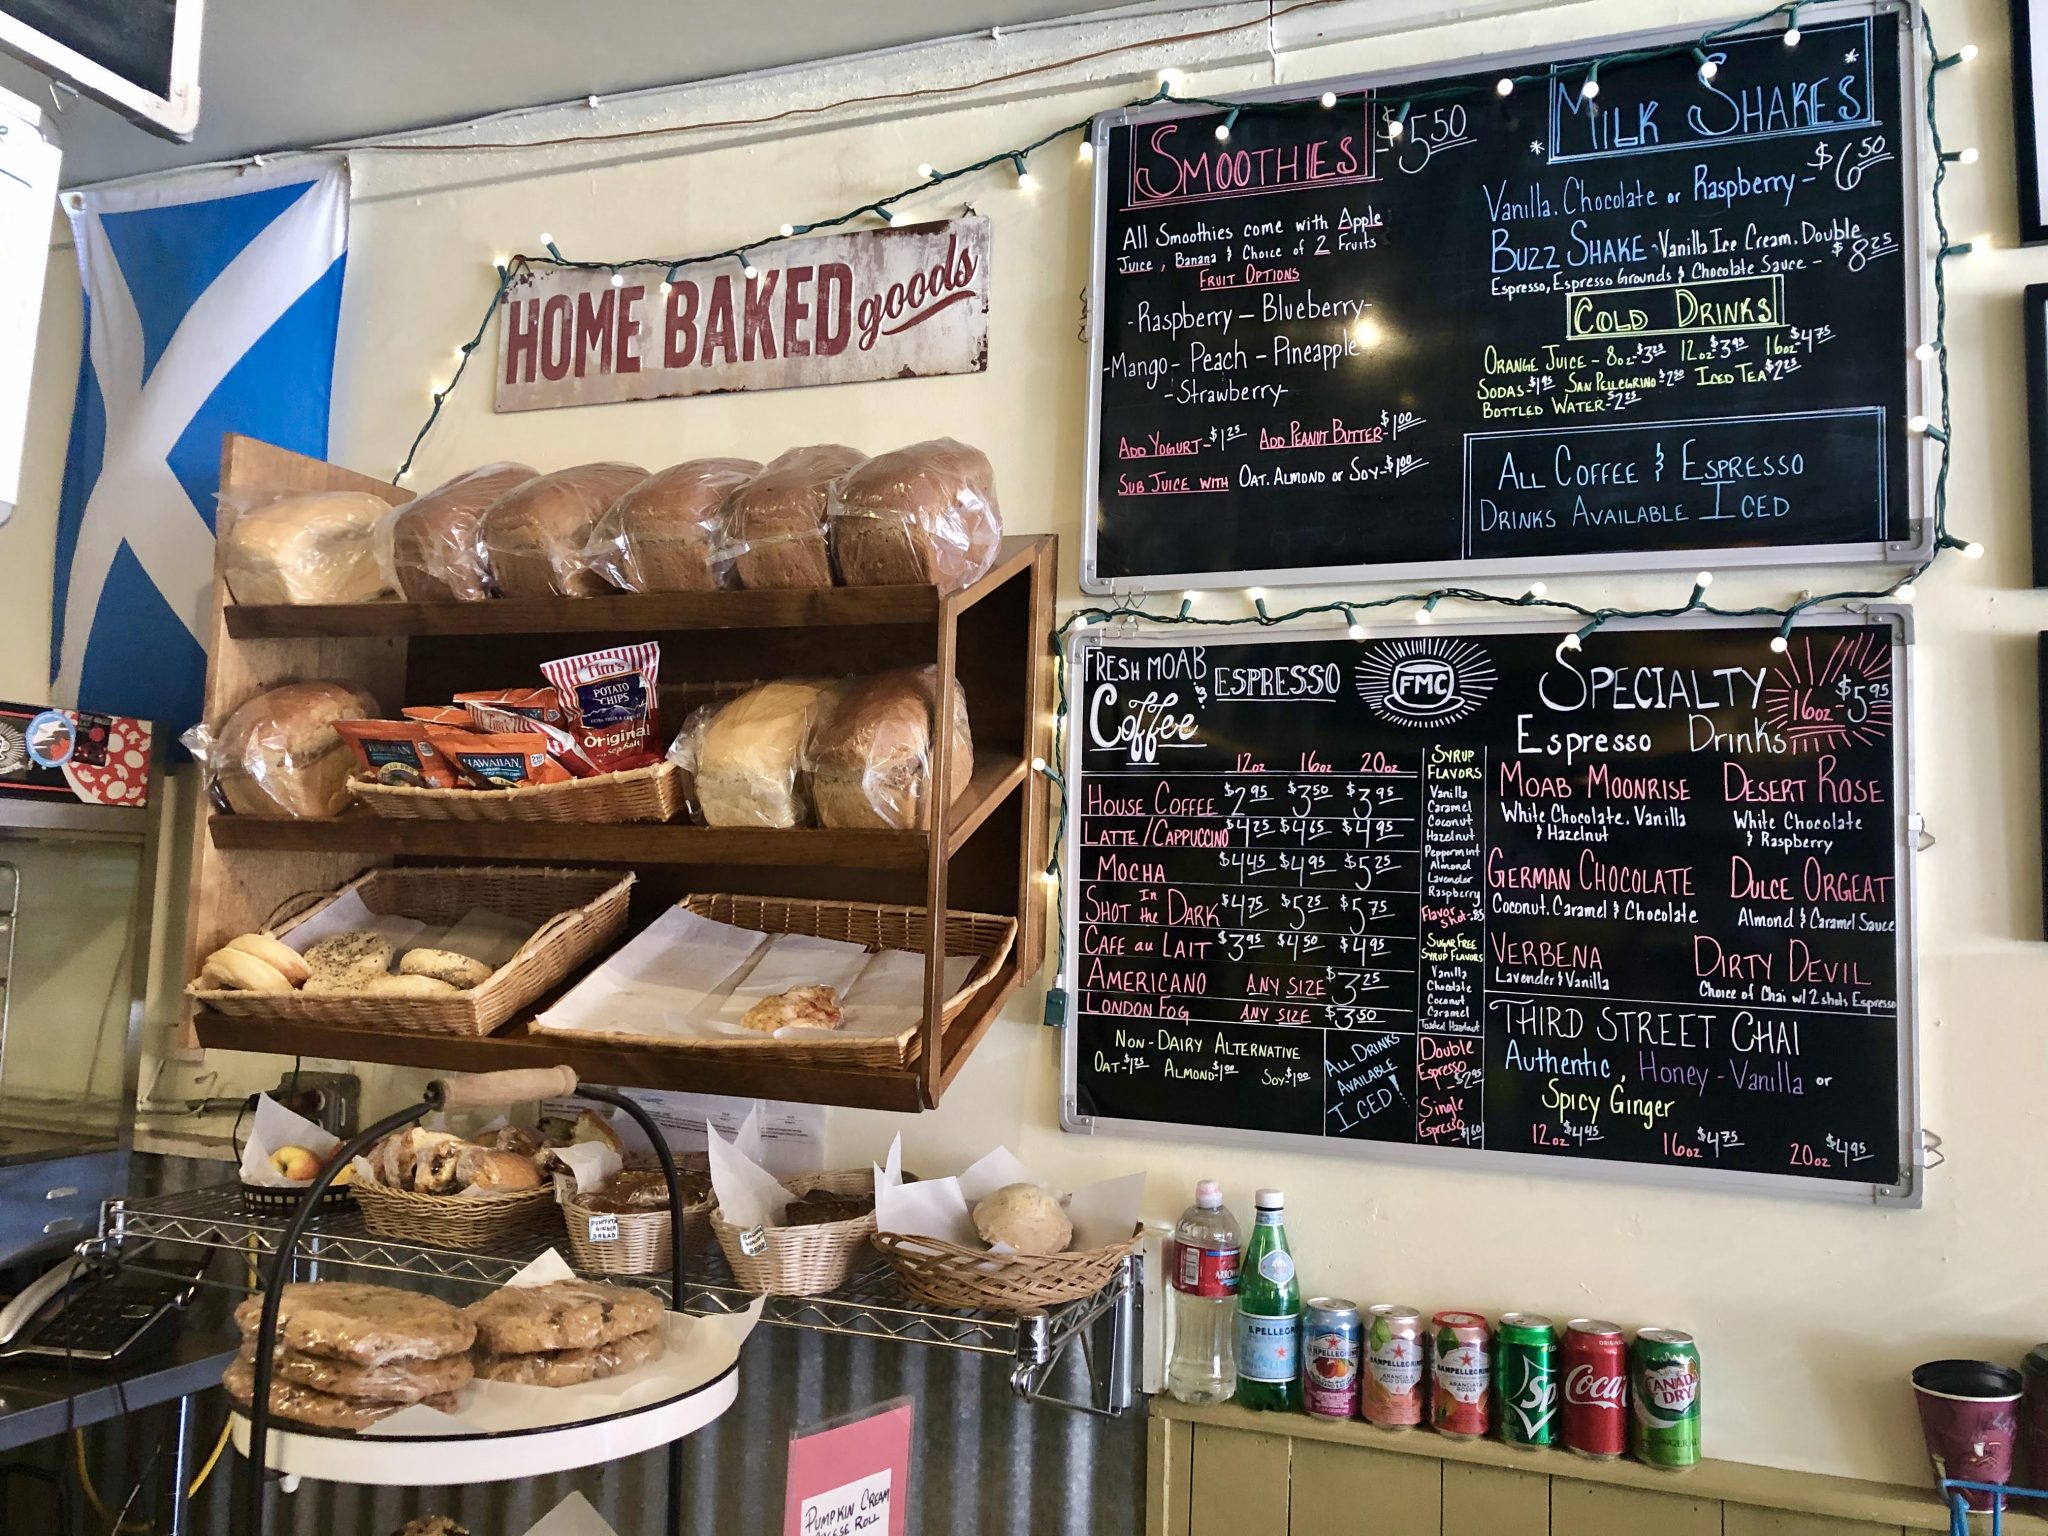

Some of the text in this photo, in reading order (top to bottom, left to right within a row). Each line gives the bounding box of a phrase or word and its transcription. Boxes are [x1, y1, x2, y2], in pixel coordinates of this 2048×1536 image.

[1556, 53, 1861, 153] MILK SHAKES
[1136, 125, 1358, 198] SMOOTHIES
[1563, 164, 1796, 216] Chocolate or Raspberry
[1123, 205, 1382, 250] All Smoothies come with Apple
[1242, 236, 1376, 260] Choice of 2 Fruits
[1492, 218, 1860, 273] BUZZ SHAKE Ice Double
[1200, 259, 1300, 288] FRUIT OPTIONS
[1553, 253, 1807, 294] Espresso Grounds Chocolate Sauce
[506, 233, 978, 384] HOME BAKED goods
[1574, 289, 1773, 334] COLD DRINKS
[1191, 329, 1361, 372] Peach Pineapple
[1484, 345, 1587, 375] ORANGE JUICE
[1565, 367, 1734, 393] SAN ICED
[1482, 401, 1544, 418] BOTTLED
[1119, 436, 1147, 457] ADD
[1260, 421, 1330, 448] ADD PEANUT
[1499, 439, 1804, 490] ALL COFFEE ESPRESSO
[1118, 469, 1342, 494] SUB JUICE WITH ALMOND or
[1481, 482, 1791, 532] DRINKS AVAILABLE ICED
[1085, 646, 1207, 681] FRESH MOAB
[1539, 641, 1767, 711] SPECIALTY
[593, 682, 630, 698] POTATO
[1215, 663, 1340, 696] ESPRESSO
[1400, 674, 1447, 695] FMC
[600, 693, 630, 705] CHIPS
[1091, 684, 1199, 762] Coffee
[1517, 714, 1787, 765] Espresso Drinks
[1432, 744, 1475, 763] SYRUP
[1428, 764, 1482, 780] FLAVORS
[1501, 761, 1690, 801] MOAB MOONRISE
[1724, 755, 1885, 803] DESERT ROSE
[1089, 781, 1218, 816] HOUSE COFFEE
[1430, 785, 1467, 799] Vanilla
[1428, 800, 1472, 813] Caramel
[1501, 802, 1687, 827] White Vanilla
[1428, 814, 1473, 828] Coconut
[1733, 810, 1863, 830] White Chocolate
[1426, 829, 1475, 841] Hazelnut
[1547, 824, 1609, 843] Hazelnut
[1761, 831, 1833, 854] Raspberry
[1425, 844, 1480, 862] Peppermint
[1430, 860, 1471, 870] Almond
[1098, 854, 1166, 882] MOCHA
[1428, 874, 1473, 883] Lavender
[1488, 847, 1696, 897] GERMAN CHOCOLATE
[1731, 855, 1895, 903] DULCE ORGEAT
[1086, 885, 1131, 923] SHOT
[1139, 889, 1157, 901] In
[1168, 889, 1220, 927] DARK
[1429, 886, 1480, 907] Raspberry
[1140, 907, 1158, 926] the
[1552, 895, 1699, 924] Caramel Chocolate
[1738, 908, 1896, 932] Almond Caramel Sauce
[1085, 925, 1213, 959] CAFE au LAIT
[1427, 933, 1477, 949] SUGAR FREE
[1491, 932, 1602, 970] VERBENA
[1421, 948, 1483, 963] SYRUP FLAVORS
[1694, 935, 1872, 985] DIRTY DEVIL
[1087, 958, 1325, 997] AMERICANO ANY SIZE
[1432, 965, 1467, 979] Vanilla
[1496, 966, 1609, 991] Lavender Vanilla
[1427, 980, 1472, 993] Chocolate
[1427, 994, 1465, 1005] Coconut
[1699, 981, 1737, 1000] Choice
[1741, 984, 1754, 1001] of
[1761, 985, 1786, 1003] Chai
[1087, 993, 1189, 1025] LONDON FOG
[1240, 1007, 1311, 1023] ANY SIZE
[1427, 1006, 1469, 1018] Caramel
[1490, 1000, 1800, 1056] THIRD STREET CHAI
[1215, 1033, 1300, 1059] ALTERNATIVE
[1325, 1033, 1401, 1077] ALL DRINKS
[1420, 1037, 1474, 1060] Double
[1337, 1058, 1398, 1096] AVAILABLE
[1418, 1061, 1466, 1090] Espresso
[1816, 1073, 1833, 1087] or
[1419, 1096, 1464, 1121] Single
[1543, 1078, 1675, 1131] Spicy Ginger
[1418, 1118, 1464, 1144] Espresso
[1663, 1386, 1692, 1404] DRY
[805, 1488, 889, 1533] PUMPKIN CREAM
[855, 1513, 880, 1530] ROLL
